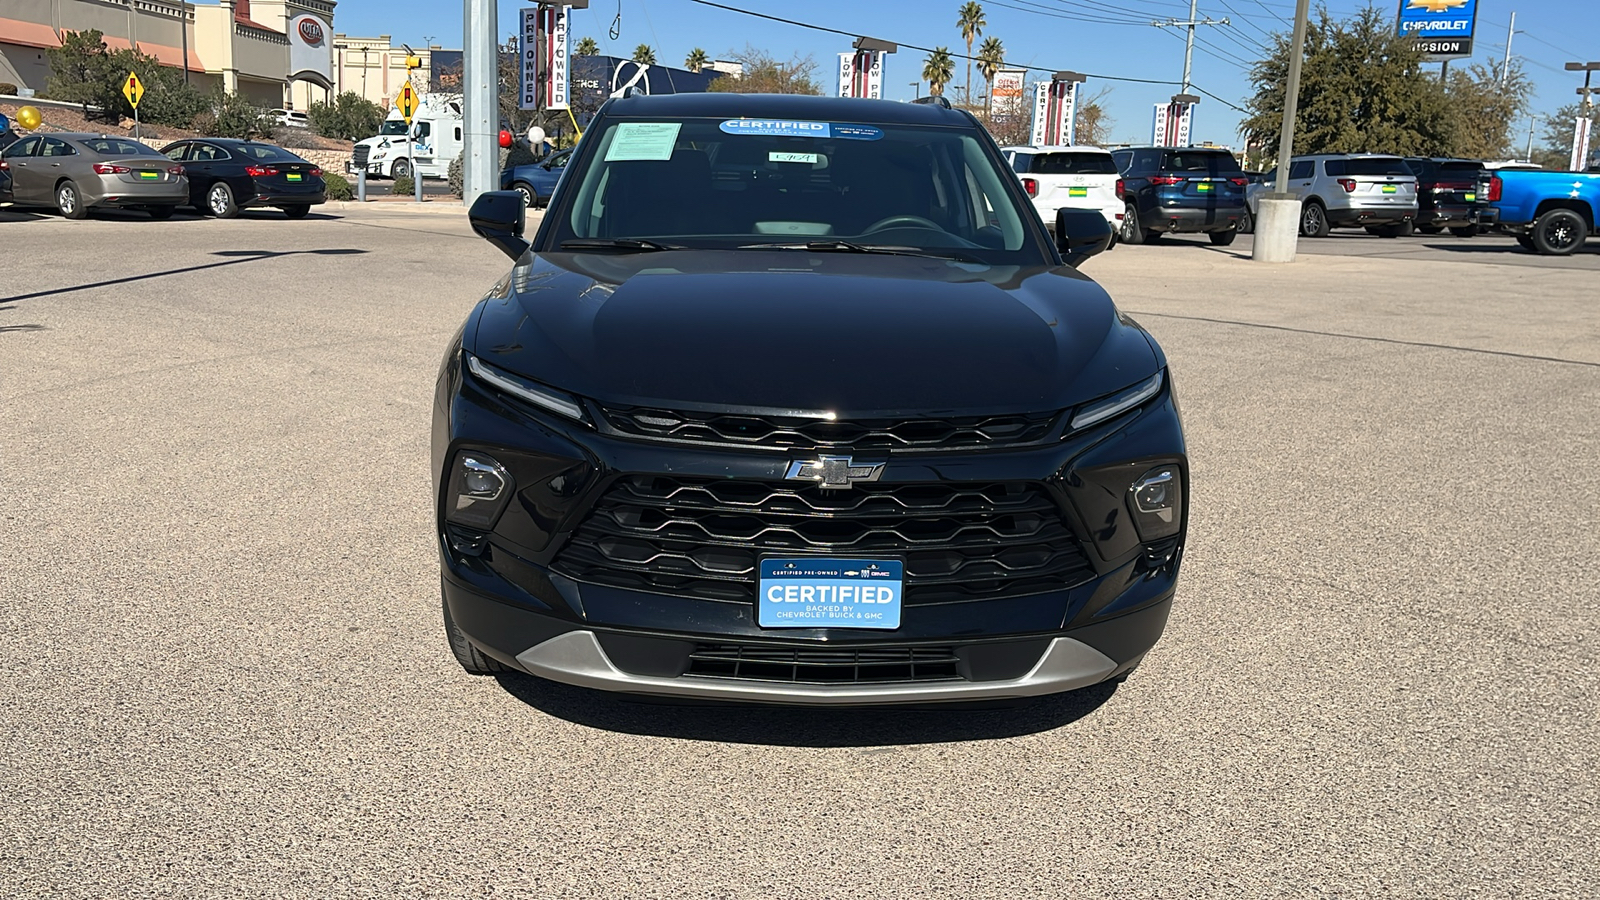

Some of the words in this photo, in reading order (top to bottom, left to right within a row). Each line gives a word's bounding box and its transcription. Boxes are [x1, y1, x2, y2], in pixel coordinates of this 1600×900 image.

[525, 13, 535, 43] PRE
[556, 12, 566, 43] PRE
[1402, 20, 1469, 31] CHEVROLET
[525, 50, 535, 104] OWNED
[555, 49, 565, 103] OWNED
[842, 56, 851, 78] LOW
[871, 55, 880, 78] LOW
[726, 120, 824, 131] CERTIFIED
[1035, 84, 1046, 143] CERTIFIED
[1062, 84, 1074, 144] CERTIFIED
[767, 585, 894, 604] CERTIFIED
[776, 611, 826, 619] CHEVROLET
[829, 611, 854, 619] BUICK
[864, 612, 883, 620] GMC
